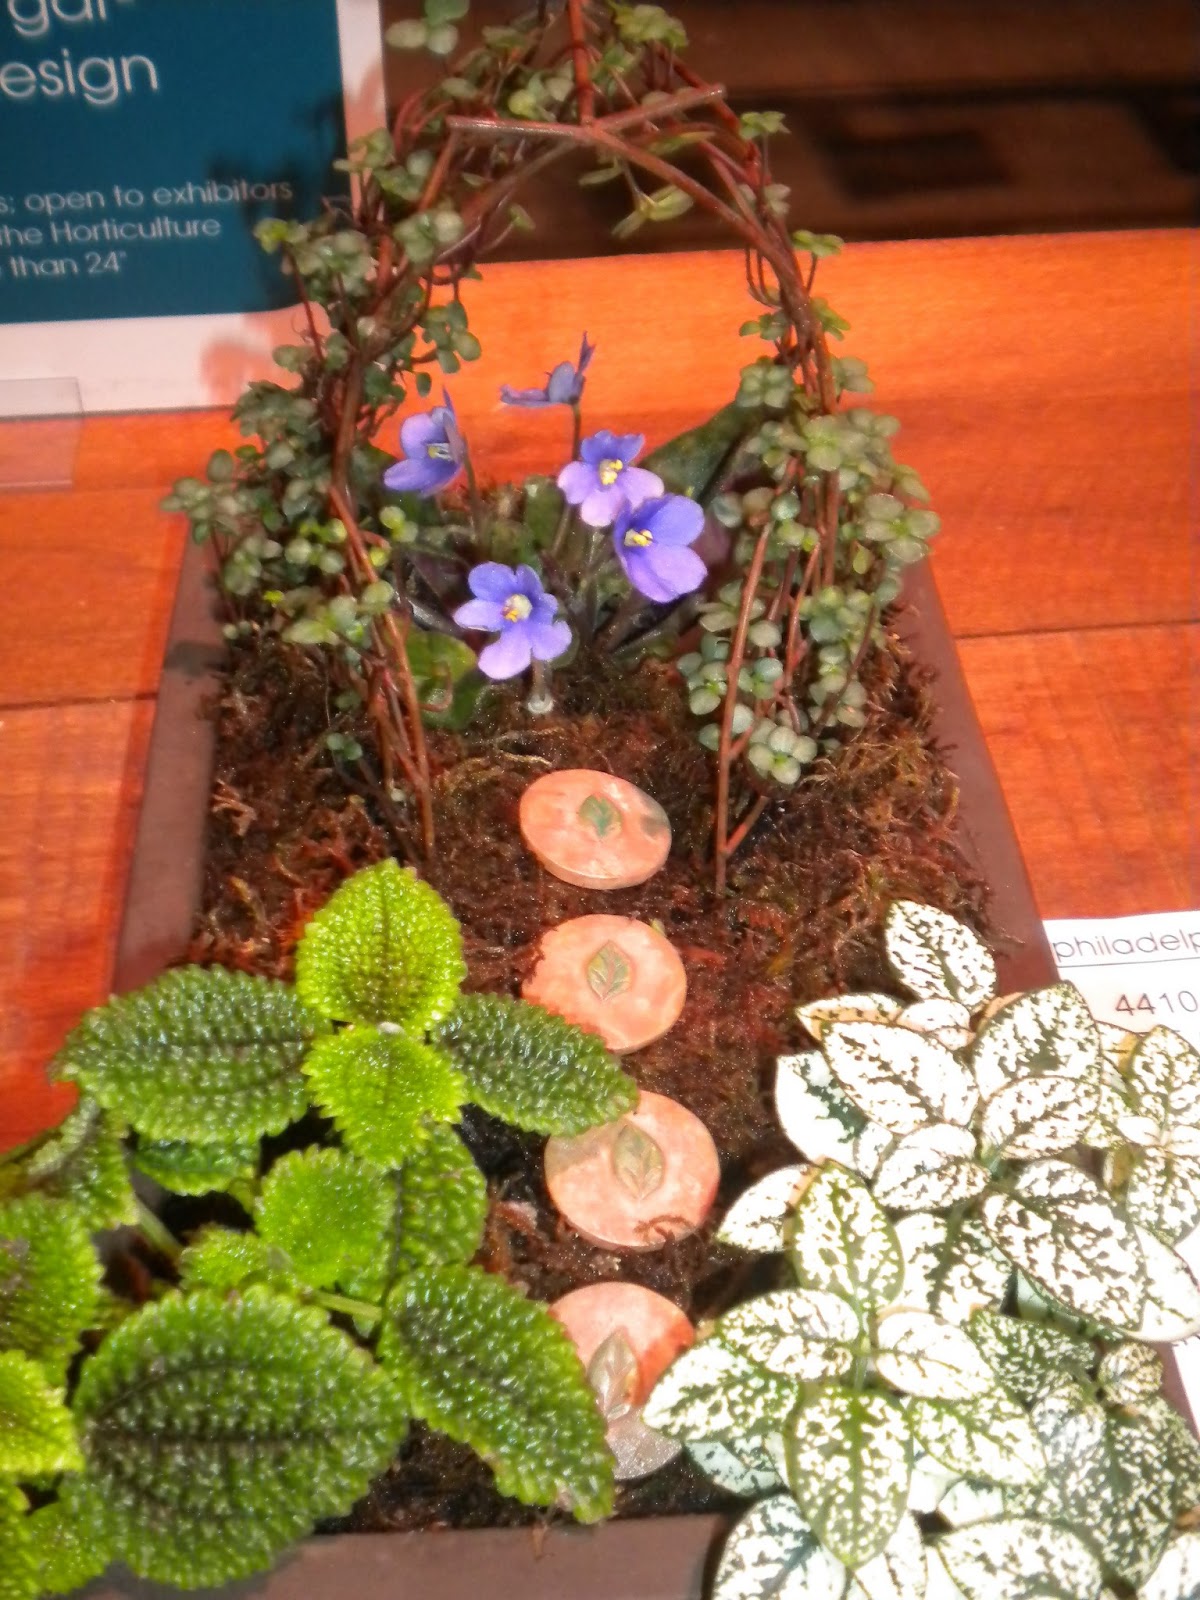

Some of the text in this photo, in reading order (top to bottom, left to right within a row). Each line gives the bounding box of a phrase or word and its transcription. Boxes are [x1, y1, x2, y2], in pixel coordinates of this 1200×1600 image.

[0, 48, 158, 105] esign
[25, 190, 105, 216] open
[113, 185, 144, 207] to
[152, 179, 293, 205] exhibitors
[0, 216, 221, 246] he Horticulture
[10, 256, 79, 277] than
[1052, 928, 1200, 962] philadelp
[1115, 990, 1198, 1016] 4410
